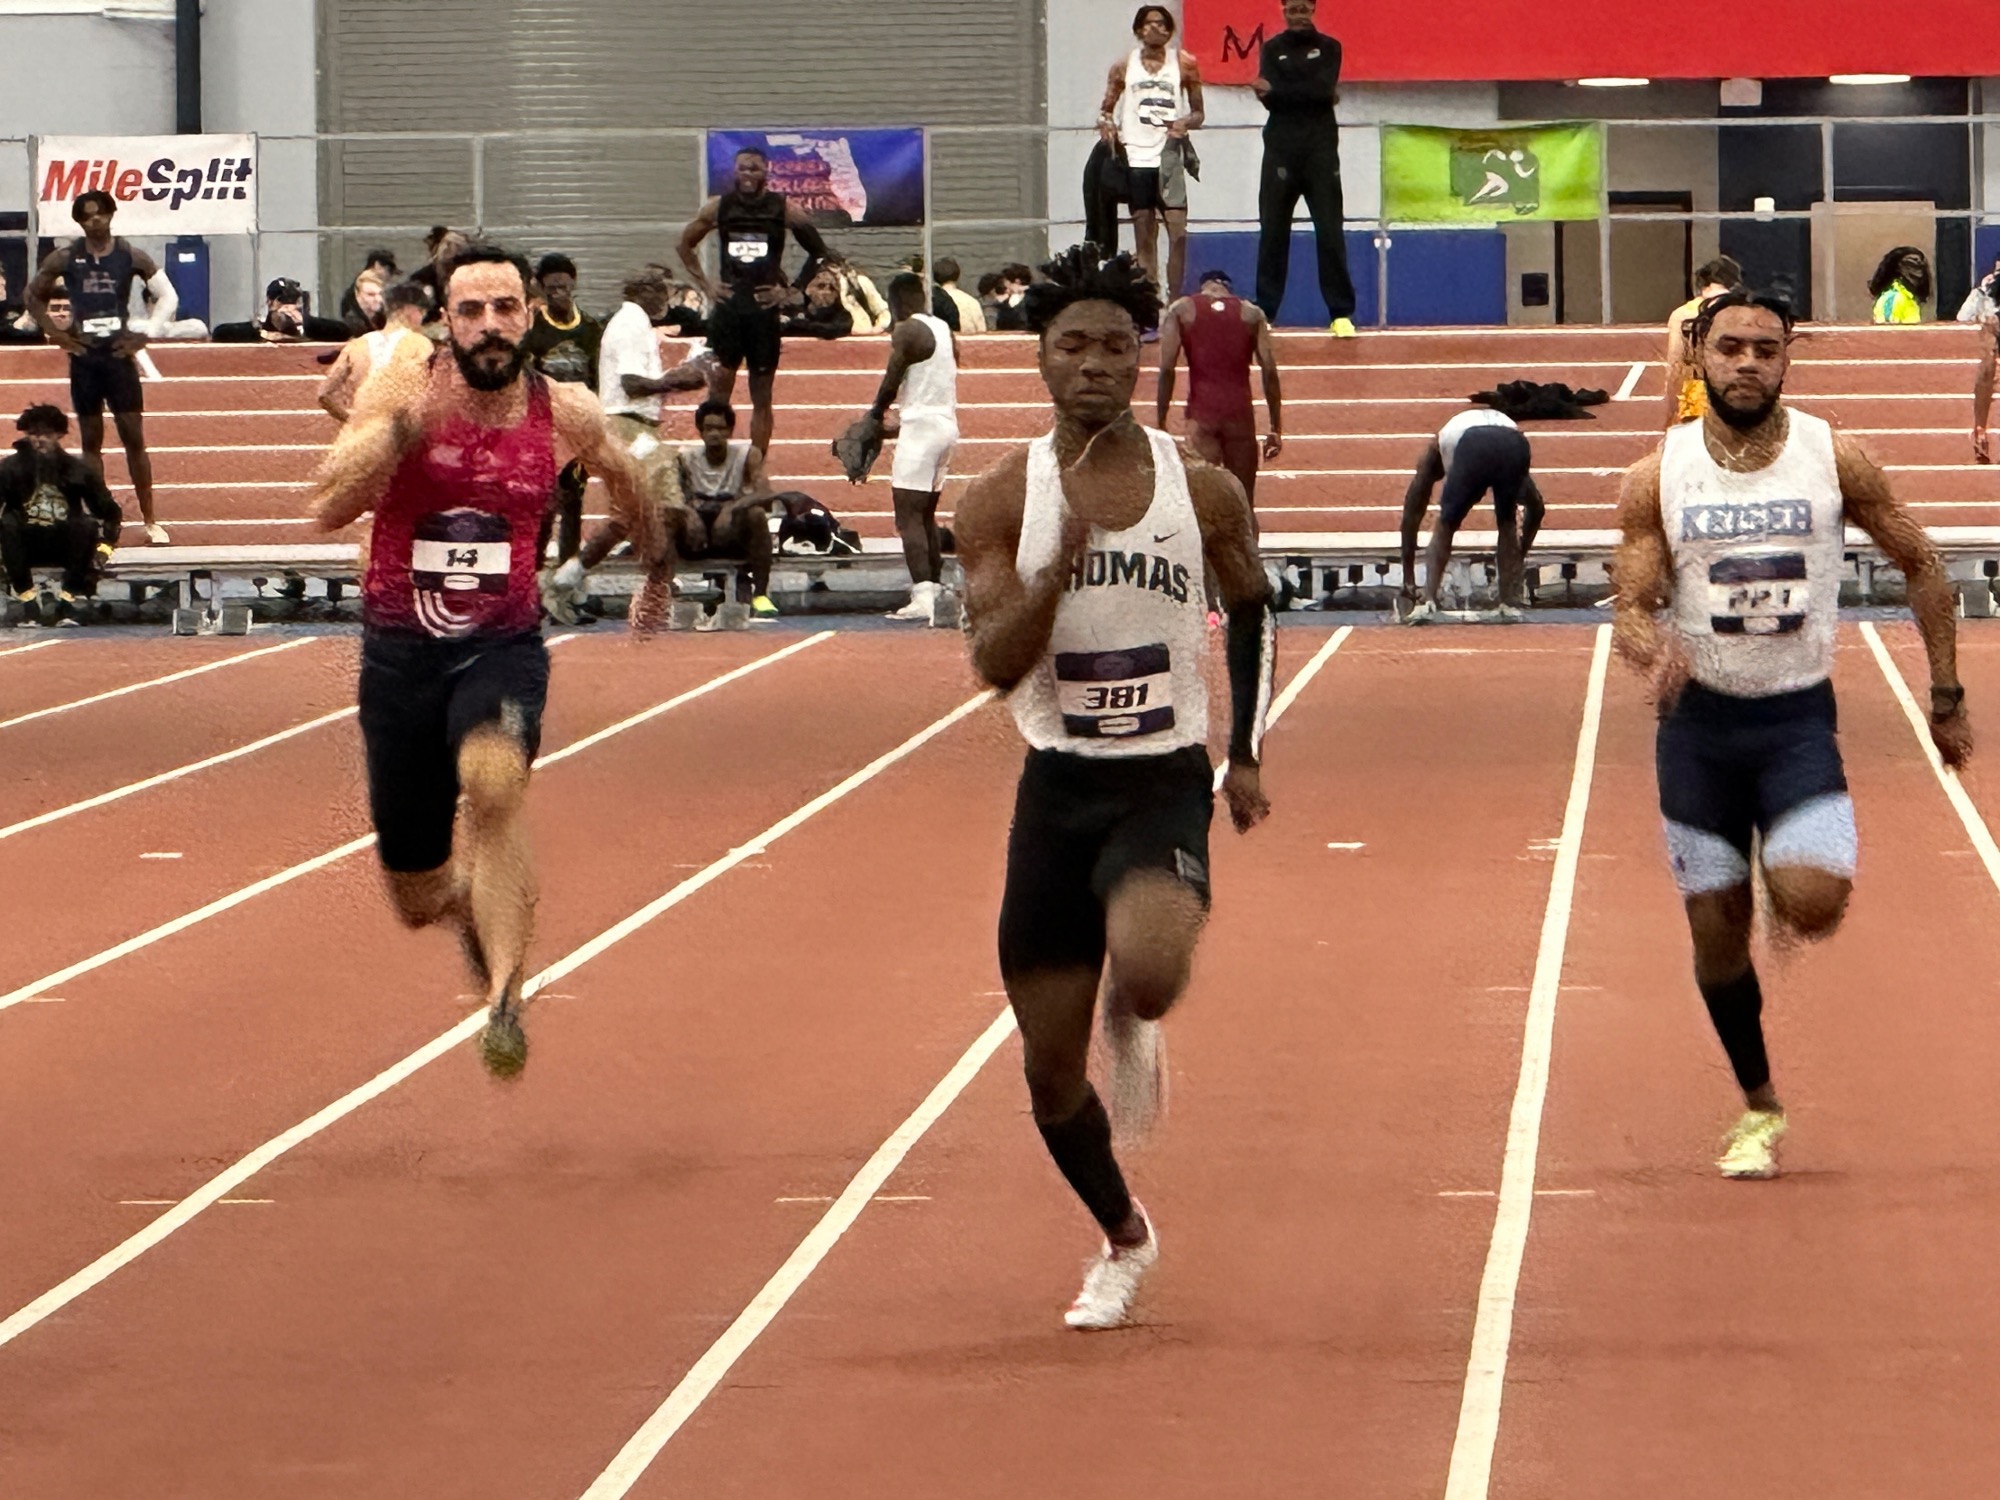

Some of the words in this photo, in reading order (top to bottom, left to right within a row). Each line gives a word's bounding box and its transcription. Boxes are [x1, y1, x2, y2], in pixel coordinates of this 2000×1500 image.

[40, 157, 252, 210] MileSplit
[1064, 550, 1190, 603] HOMAS
[1083, 683, 1149, 709] 381
